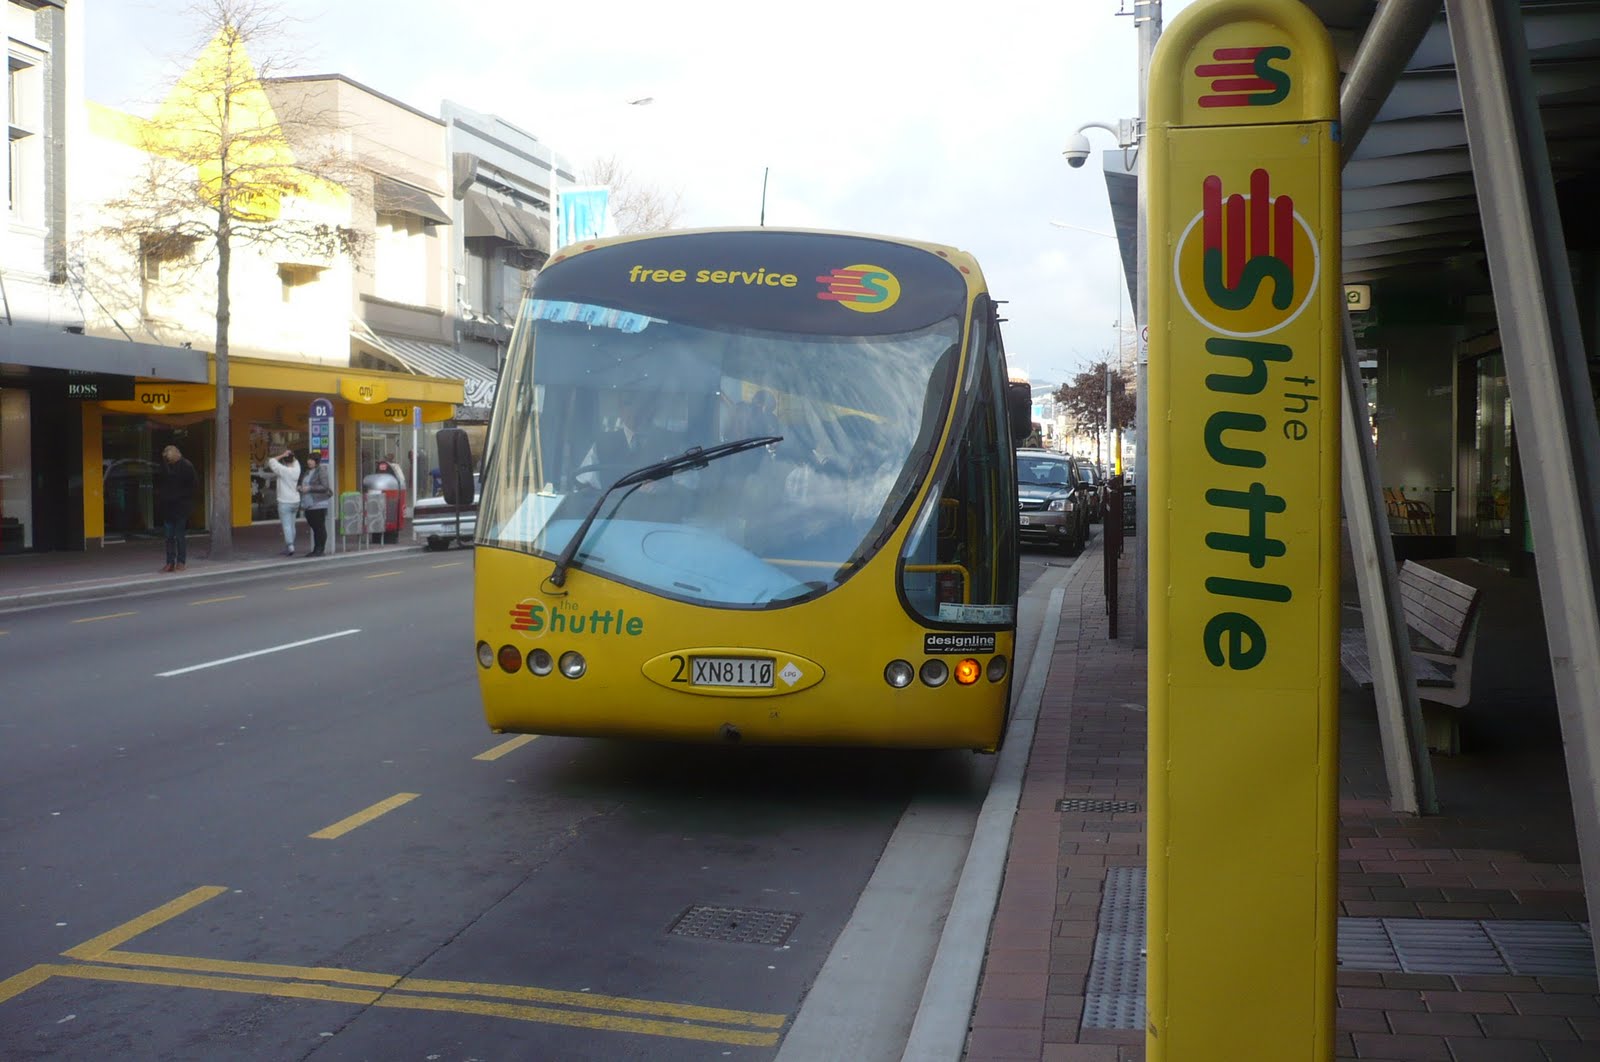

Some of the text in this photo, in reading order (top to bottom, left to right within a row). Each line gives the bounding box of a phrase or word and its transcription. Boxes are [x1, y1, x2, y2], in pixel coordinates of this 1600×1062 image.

[629, 265, 798, 288] free service
[69, 384, 98, 394] BOSS
[316, 406, 327, 417] D1
[1284, 376, 1320, 442] the
[1203, 247, 1293, 671] Shuttle
[560, 600, 579, 611] the
[527, 604, 644, 636] Shuttle
[927, 635, 995, 647] designline
[670, 655, 688, 683] 2
[695, 661, 772, 684] XN8110
